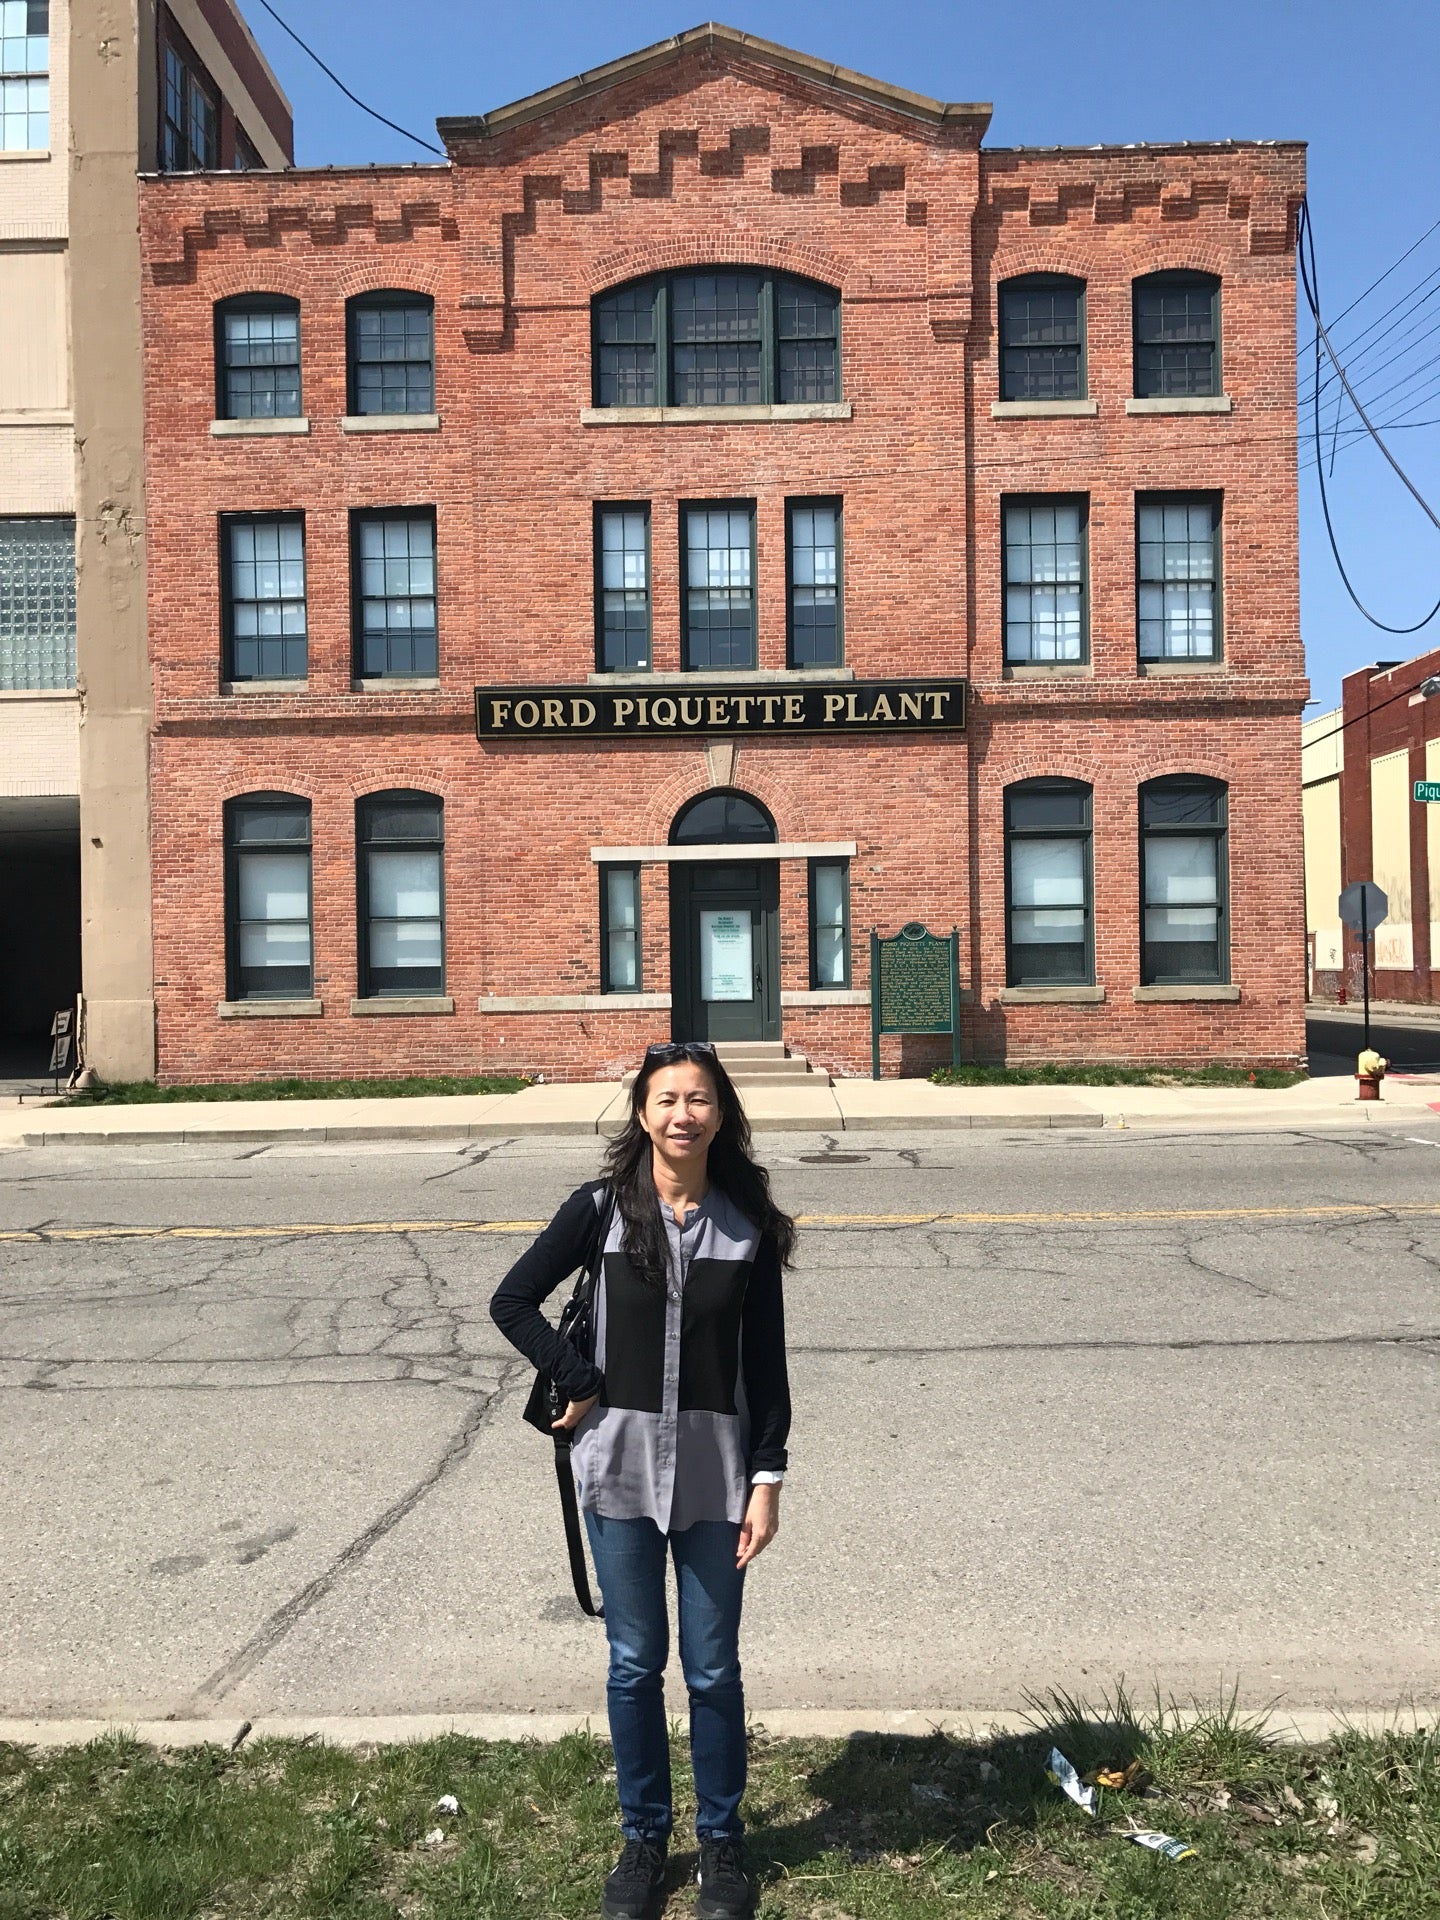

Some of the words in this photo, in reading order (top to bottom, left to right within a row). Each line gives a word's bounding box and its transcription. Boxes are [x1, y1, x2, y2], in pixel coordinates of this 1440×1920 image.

[491, 699, 597, 728] FORD
[612, 695, 805, 727] PIQUETTE
[823, 691, 950, 723] PLANT
